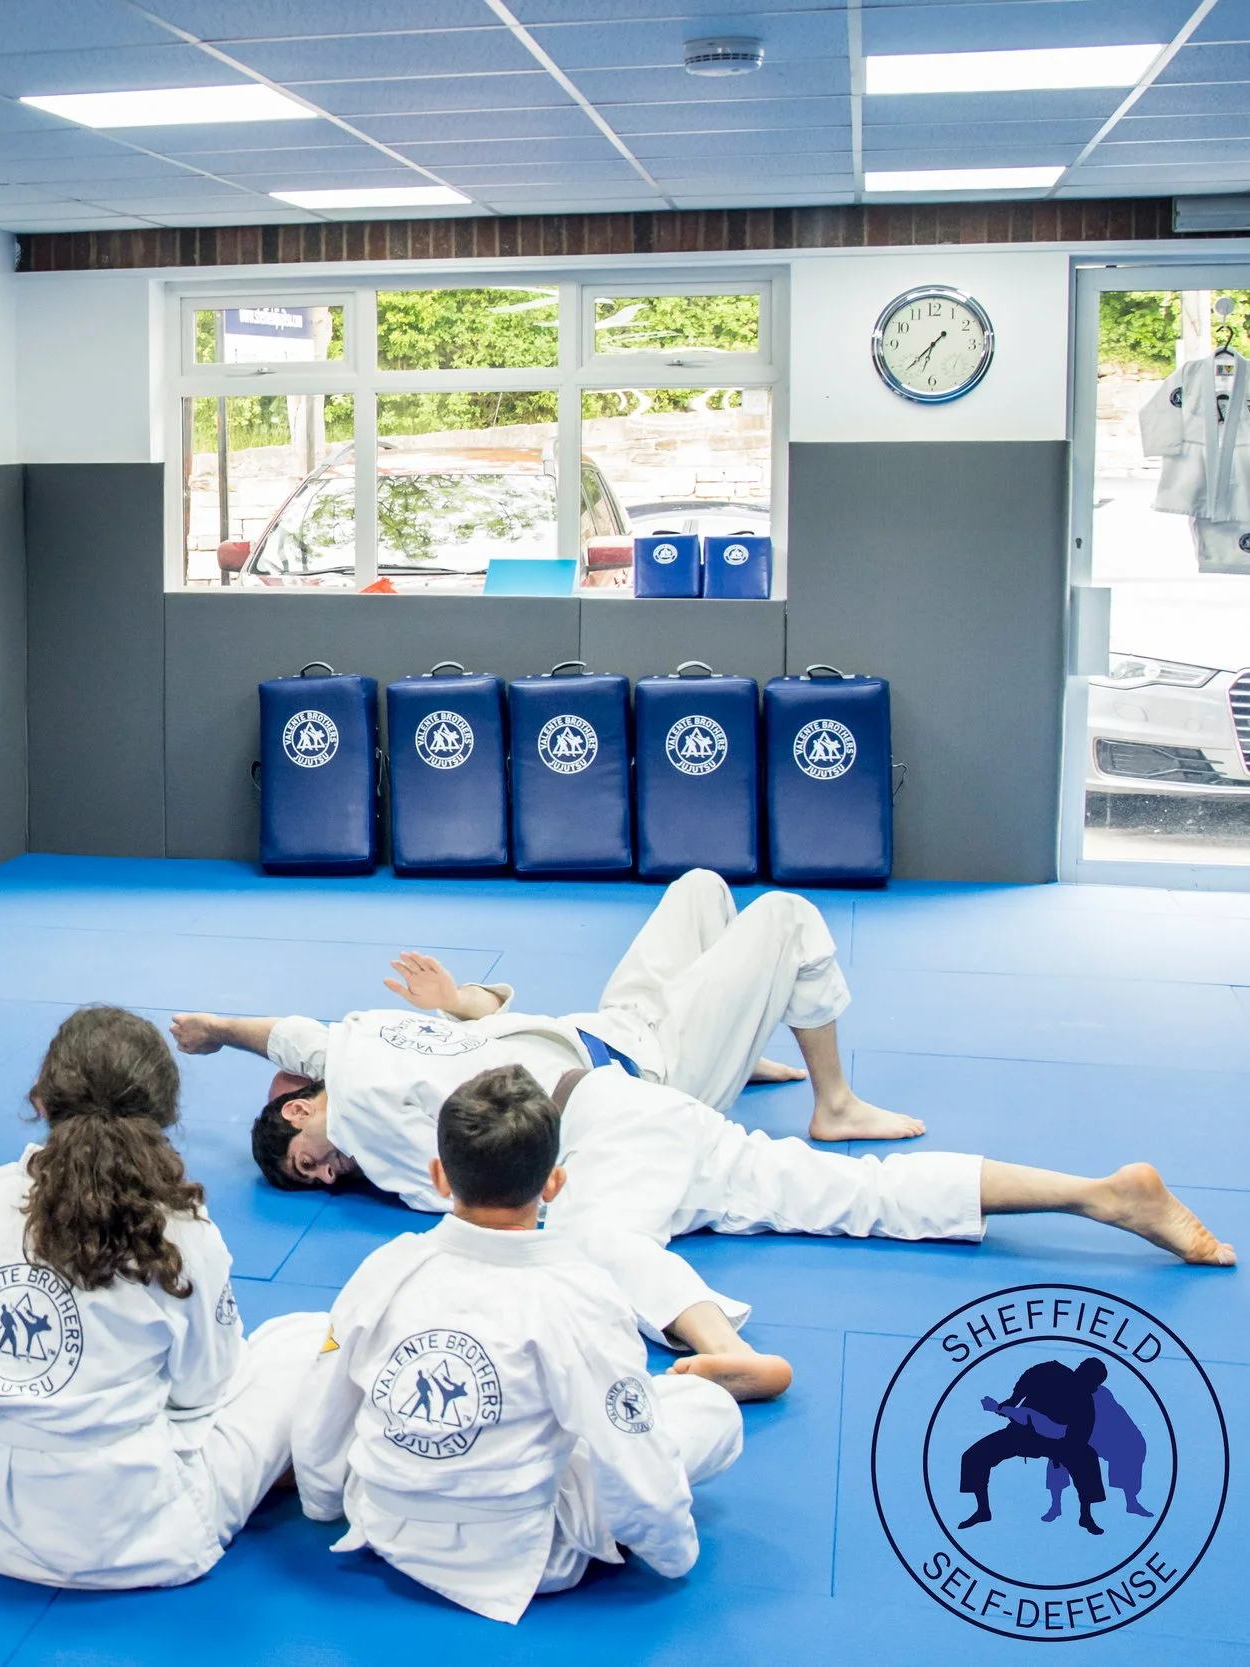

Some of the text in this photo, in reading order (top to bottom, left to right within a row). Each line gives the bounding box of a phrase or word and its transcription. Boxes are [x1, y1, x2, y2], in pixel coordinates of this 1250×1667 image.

[911, 308, 921, 320] 11
[927, 302, 941, 316] 12
[897, 321, 909, 333] 10
[961, 320, 970, 332] 2
[889, 339, 899, 351] 9
[967, 339, 976, 350] 3
[928, 375, 937, 387] 6
[285, 712, 337, 745] VALENTE BROTHERS
[417, 712, 471, 746] VALENTE BROTHERS
[540, 717, 595, 750] VALENTE BROTHERS
[668, 717, 725, 751] VALENTE BROTHERS
[795, 721, 854, 755] VALENTE BROTHERS
[293, 752, 330, 766] JUJUTSU
[426, 753, 464, 767] JUJUTSU
[549, 758, 588, 772] JUJUTSU
[676, 760, 716, 773] JUJUTSU
[805, 763, 845, 778] JUJUTSU
[27, 1268, 79, 1354] BROTHERS
[376, 1334, 498, 1422] VALENTE BROTHERS
[388, 1427, 468, 1455] JUJUTSU
